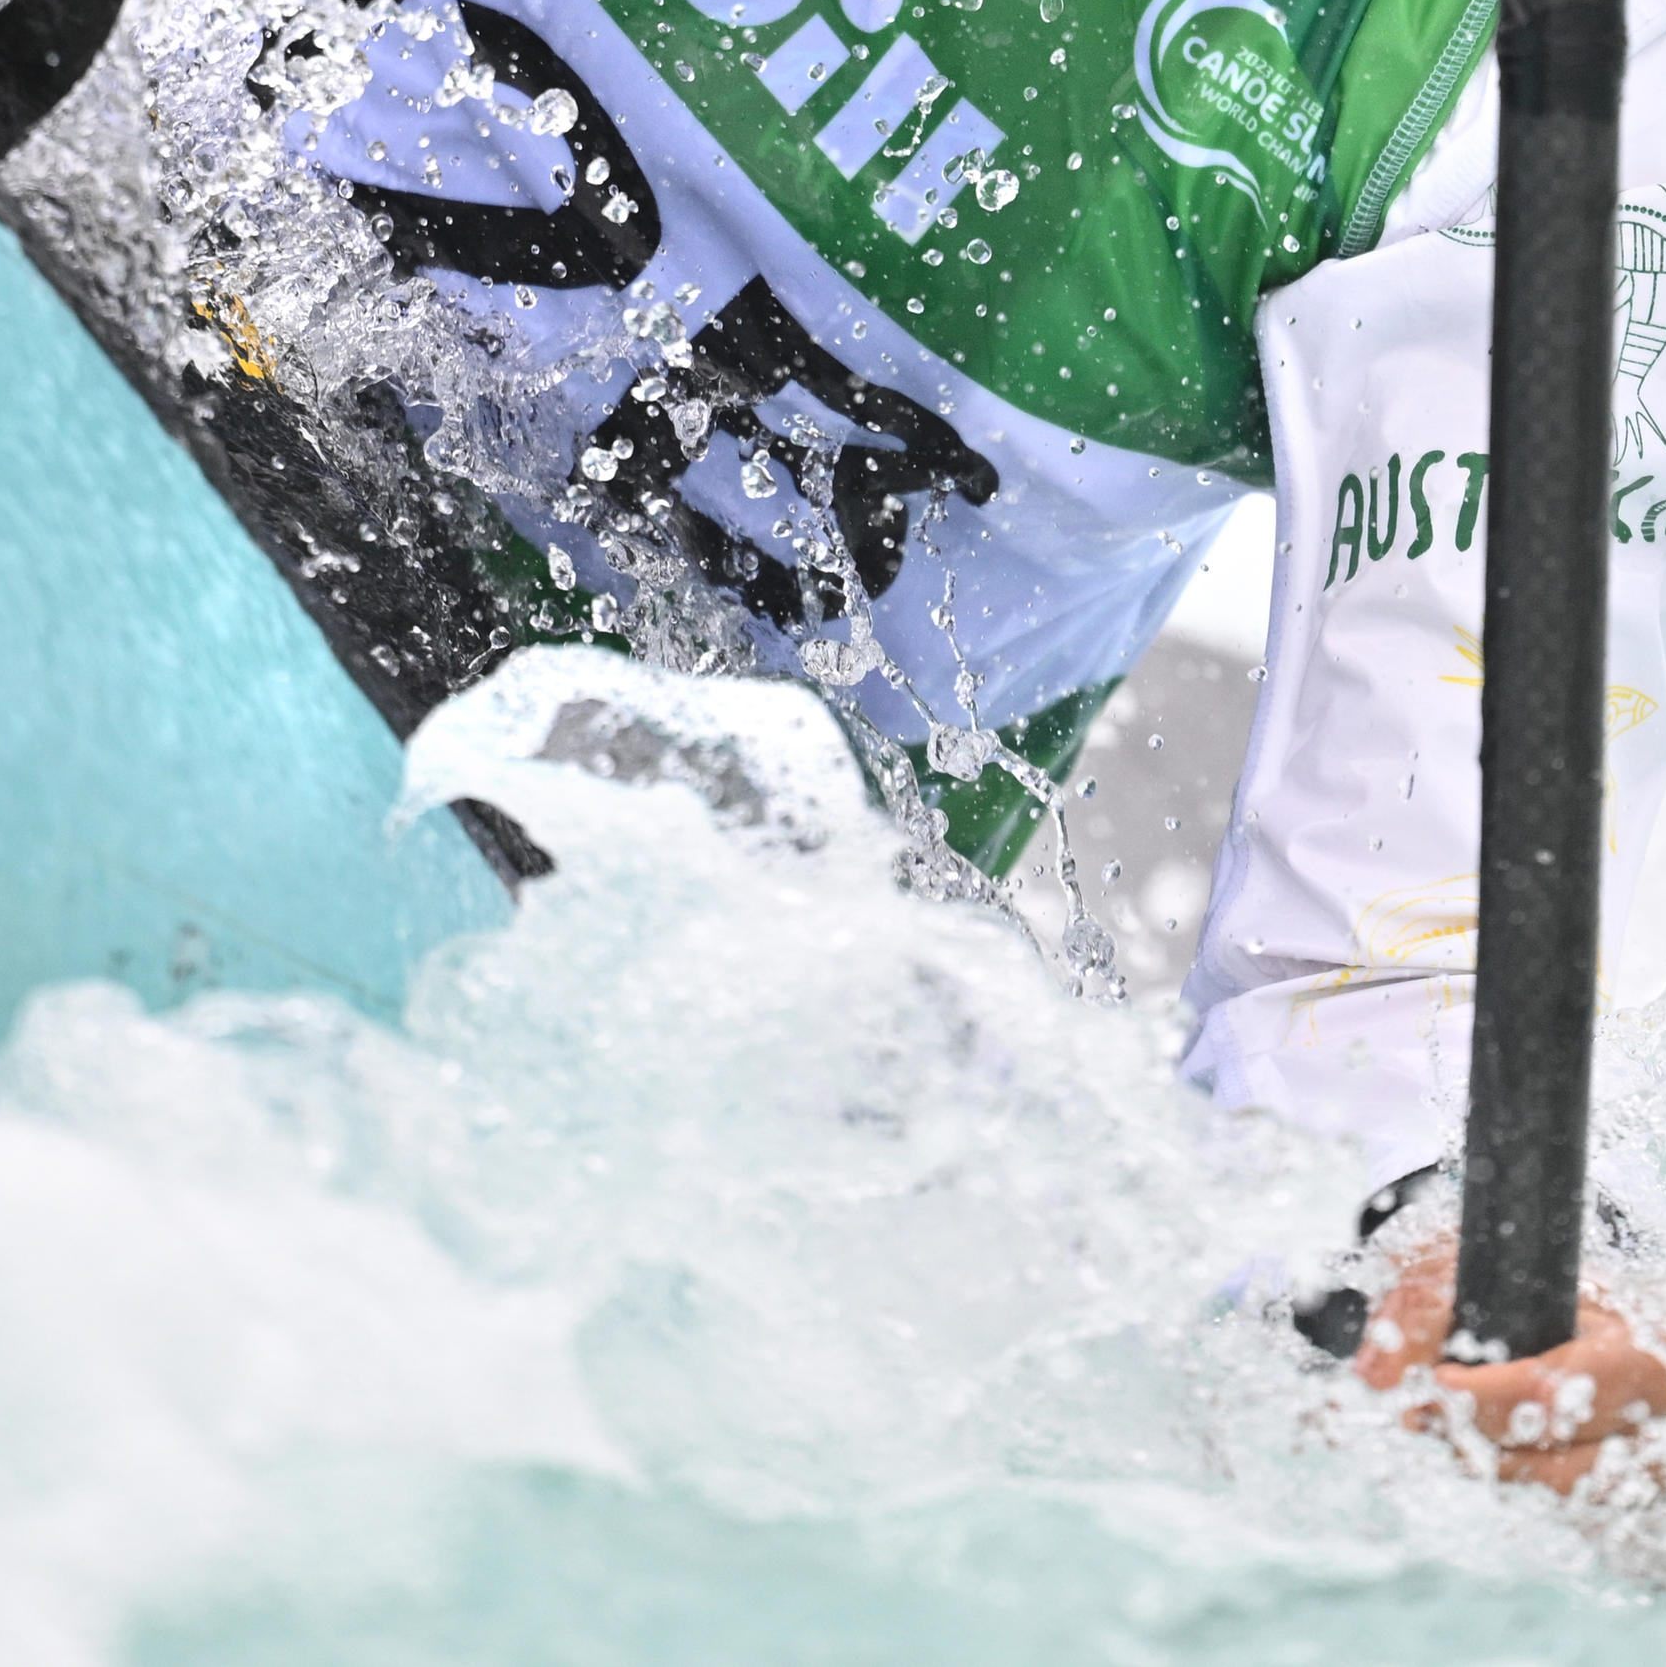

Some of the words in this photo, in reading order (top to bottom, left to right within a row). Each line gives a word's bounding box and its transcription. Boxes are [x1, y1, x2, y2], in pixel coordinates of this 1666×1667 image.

[1183, 36, 1286, 124] CANOE
[1235, 45, 1274, 80] 2023
[1200, 82, 1258, 133] WORLD
